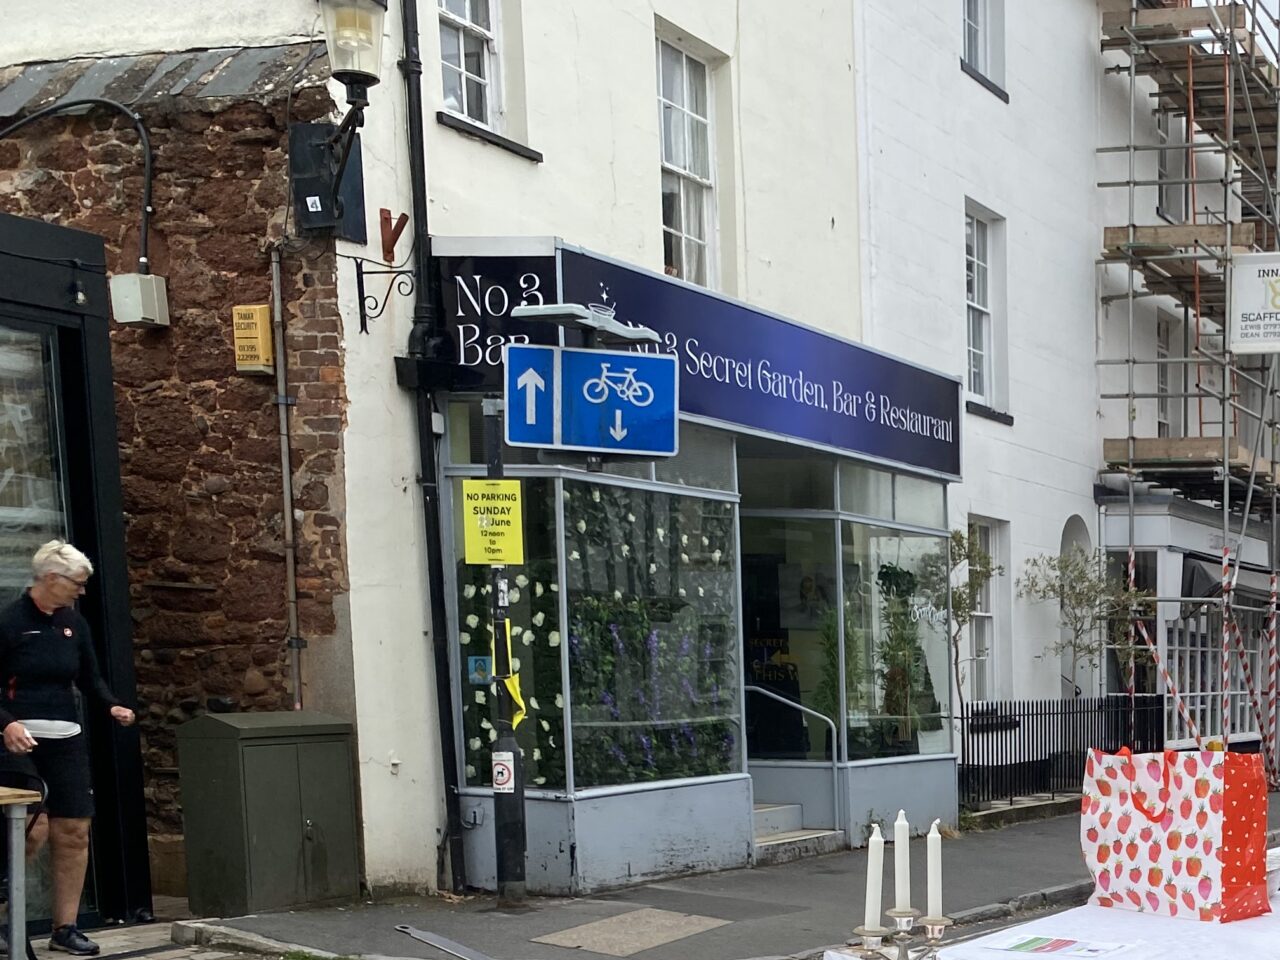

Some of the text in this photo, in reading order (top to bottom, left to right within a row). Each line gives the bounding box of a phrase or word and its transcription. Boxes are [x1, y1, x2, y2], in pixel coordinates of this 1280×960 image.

[454, 275, 508, 316] No
[235, 322, 257, 330] SECURITY
[685, 338, 752, 390] Secret
[758, 359, 828, 411] Garden,
[832, 381, 862, 418] Bar
[865, 391, 877, 422] &
[880, 395, 953, 444] Restaurant
[466, 493, 517, 502] NO PARKING
[473, 506, 511, 515] SUNDAY
[490, 518, 511, 526] June
